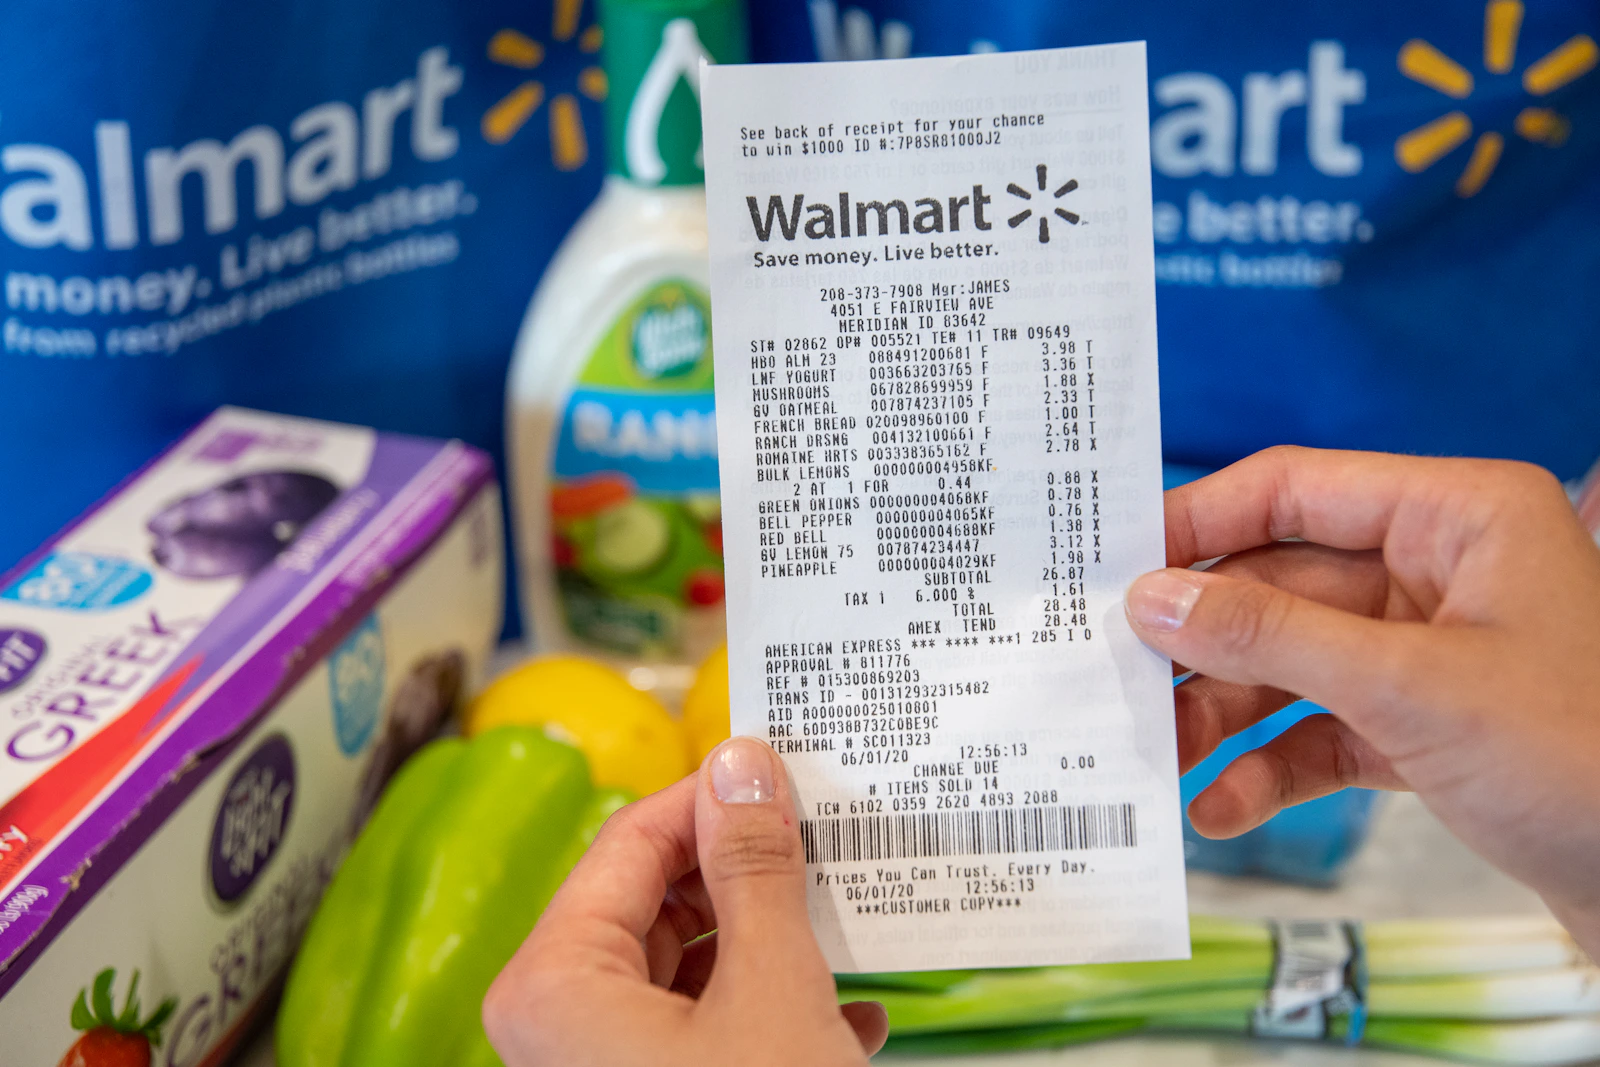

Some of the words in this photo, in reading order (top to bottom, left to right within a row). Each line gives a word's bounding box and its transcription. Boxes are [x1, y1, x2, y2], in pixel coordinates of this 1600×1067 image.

[740, 127, 764, 140] See
[775, 124, 807, 139] back
[818, 123, 833, 137] of
[845, 120, 903, 135] receipt
[914, 118, 938, 131] for
[949, 118, 982, 130] your
[993, 114, 1044, 127] chance
[0, 45, 465, 252] almart
[742, 144, 757, 157] to
[766, 143, 791, 156] win
[802, 139, 843, 155] $1000
[855, 138, 869, 152] ID
[745, 184, 992, 242] Walmart
[1187, 189, 1375, 244] better.
[753, 251, 799, 268] Save
[805, 251, 877, 267] money.
[884, 244, 924, 261] Live
[930, 242, 998, 259] better.
[3, 264, 213, 315] money.
[220, 226, 316, 291] Live
[932, 279, 1009, 296] Mgr:JAMES
[830, 302, 862, 317] 4051
[891, 298, 958, 314] FAIRVIEW
[969, 296, 993, 310] AVE
[839, 316, 907, 333] MERIDIAN
[918, 315, 933, 329] ID
[943, 312, 985, 328] 83642
[3, 317, 97, 358] from
[750, 339, 774, 353] ST#
[785, 336, 826, 351] 02862
[836, 335, 860, 348] OP#
[871, 332, 920, 347] 005521
[932, 331, 956, 344] TE#
[992, 327, 1017, 341] TR#
[1027, 324, 1070, 339] 09649
[751, 355, 775, 369] HBO
[785, 353, 810, 368] ALM
[820, 352, 836, 366] 23
[1041, 340, 1075, 355] 3.98
[751, 371, 775, 386] LNF
[786, 368, 836, 384] YOGURT
[1042, 357, 1076, 371] 3.36
[752, 385, 829, 402] MUSHROOMS
[1044, 373, 1077, 387] 1.88
[753, 404, 769, 417] GV
[779, 400, 837, 416] OATMEAL
[1043, 389, 1077, 404] 2.33
[754, 418, 804, 434] FRENCH
[814, 416, 856, 431] BREAD
[1045, 406, 1078, 420] 1.00
[755, 435, 796, 450] RANCH
[806, 432, 848, 447] DRSNG
[1045, 421, 1078, 437] 2.64
[756, 450, 814, 466] ROMAINE
[824, 448, 857, 462] HRTS
[1046, 438, 1079, 453] 2.78
[757, 467, 789, 482] BULK
[799, 464, 849, 479] LEMONS
[864, 478, 888, 492] FOR
[938, 475, 970, 490] 0.44
[1047, 470, 1080, 485] 0.88
[758, 499, 799, 514] GREEN
[809, 496, 859, 511] ONIONS
[1047, 486, 1081, 500] 0.78
[759, 515, 790, 530] BELL
[802, 512, 852, 527] PEPPER
[1048, 502, 1081, 517] 0.76
[760, 531, 784, 546] RED
[794, 529, 826, 544] BELL
[1051, 518, 1082, 532] 1.38
[760, 548, 776, 562] GV
[786, 545, 827, 561] LEMON
[838, 544, 853, 558] 75
[1050, 534, 1082, 548] 3.12
[761, 561, 836, 578] PINEAPPLE
[1052, 550, 1083, 564] 1.98
[924, 569, 991, 586] SUBTOTAL
[1042, 566, 1084, 580] 26.87
[845, 591, 868, 606] TAX
[916, 587, 957, 602] 6.000
[1052, 582, 1083, 596] 1.61
[952, 602, 994, 616] TOTAL
[1044, 597, 1085, 611] 28.48
[908, 620, 940, 635] AMEX
[963, 617, 996, 632] TEND
[1044, 613, 1086, 627] 28.48
[765, 641, 832, 658] AMERICAN
[842, 638, 901, 654] EXPRESS
[766, 657, 833, 674] APPROVAL
[860, 653, 910, 668] 811776
[766, 675, 789, 690] REF
[768, 690, 809, 706] TRANS
[820, 689, 834, 703] ID
[768, 707, 792, 722] AID
[769, 723, 792, 737] AAC
[770, 738, 836, 754] TERMINAL
[863, 732, 930, 748] SC011323
[841, 749, 908, 766] 06/01/20
[960, 743, 1027, 759] 12:56:13
[913, 762, 963, 777] CHANGE
[974, 760, 998, 774] DUE
[1061, 755, 1094, 769] 0.00
[888, 780, 928, 795] ITEMS
[939, 778, 971, 792] SOLD
[983, 776, 997, 790] 14
[816, 802, 839, 816] TC#
[850, 798, 882, 813] 6102
[892, 796, 925, 811] 0359
[936, 794, 969, 809] 2620
[980, 792, 1013, 806] 4893
[1024, 790, 1057, 804] 2088
[818, 872, 866, 885] Prices
[876, 868, 901, 882] You
[911, 866, 935, 880] Can
[947, 865, 995, 876] Trust.
[1008, 862, 1050, 875] Every
[1061, 860, 1095, 873] Day.
[846, 883, 913, 900] 06/01/20
[966, 878, 1034, 894] 12:56:13
